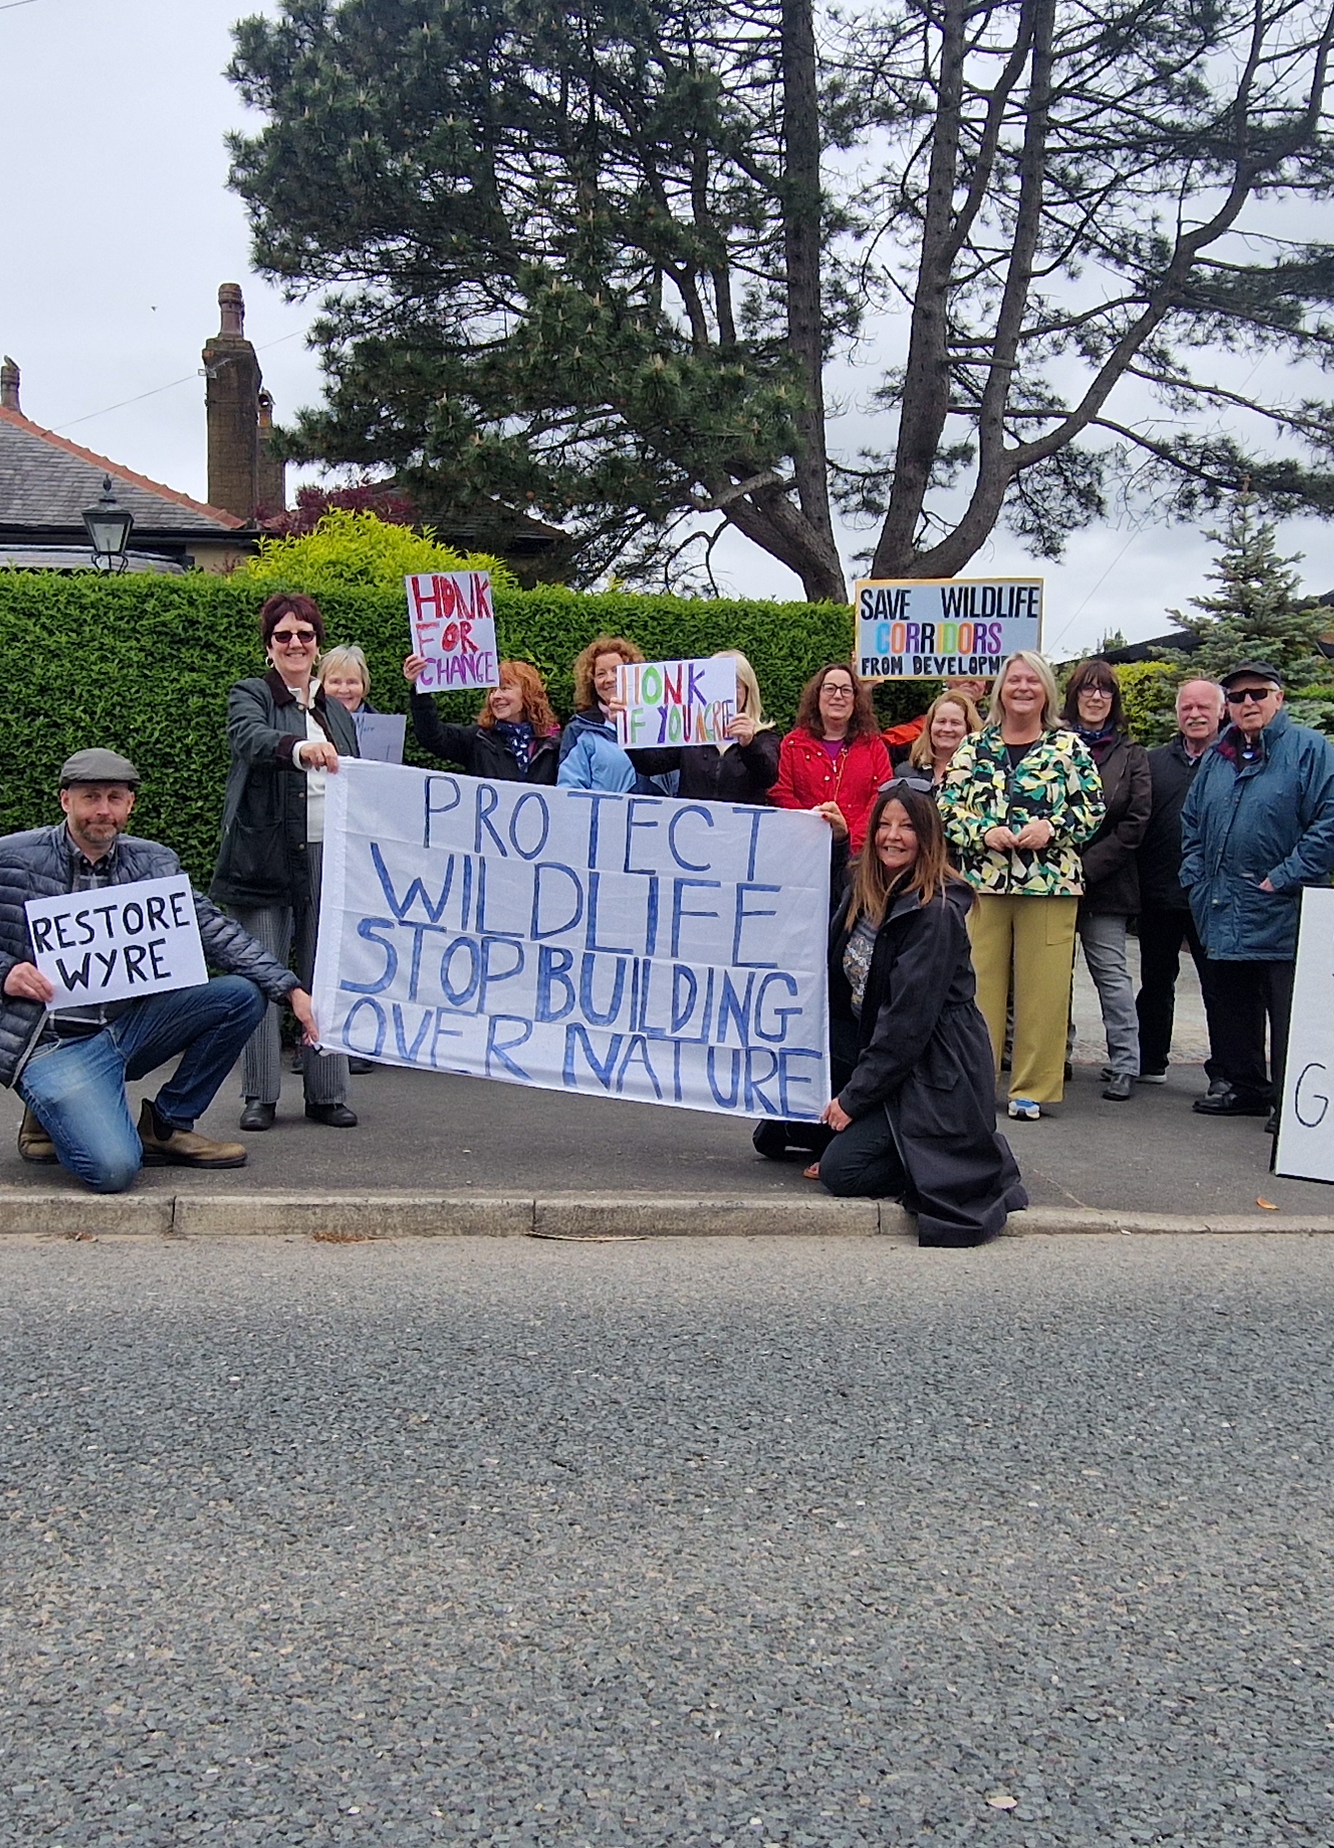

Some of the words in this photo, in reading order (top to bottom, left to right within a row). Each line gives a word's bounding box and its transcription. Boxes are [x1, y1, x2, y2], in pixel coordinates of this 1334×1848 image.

[411, 573, 492, 620] HONK
[860, 588, 911, 621] SAVE
[940, 586, 1040, 619] WILDLIFE
[416, 620, 479, 657] FOR
[875, 622, 1003, 655] CORRIDORS
[420, 652, 495, 686] CHANGE
[620, 663, 707, 707] HONK
[862, 655, 903, 676] FROM
[912, 655, 1009, 676] DEVELOPM
[622, 707, 646, 744] IF
[657, 704, 692, 744] YOU
[423, 775, 777, 881] PROTECT
[31, 892, 190, 954] RESTORE
[370, 842, 782, 969] WILDLIFE
[55, 938, 172, 991] WYRE
[340, 917, 525, 1014] STOP
[535, 944, 803, 1047] BUILDING
[343, 996, 534, 1082] OVER
[563, 1022, 822, 1120] NATURE
